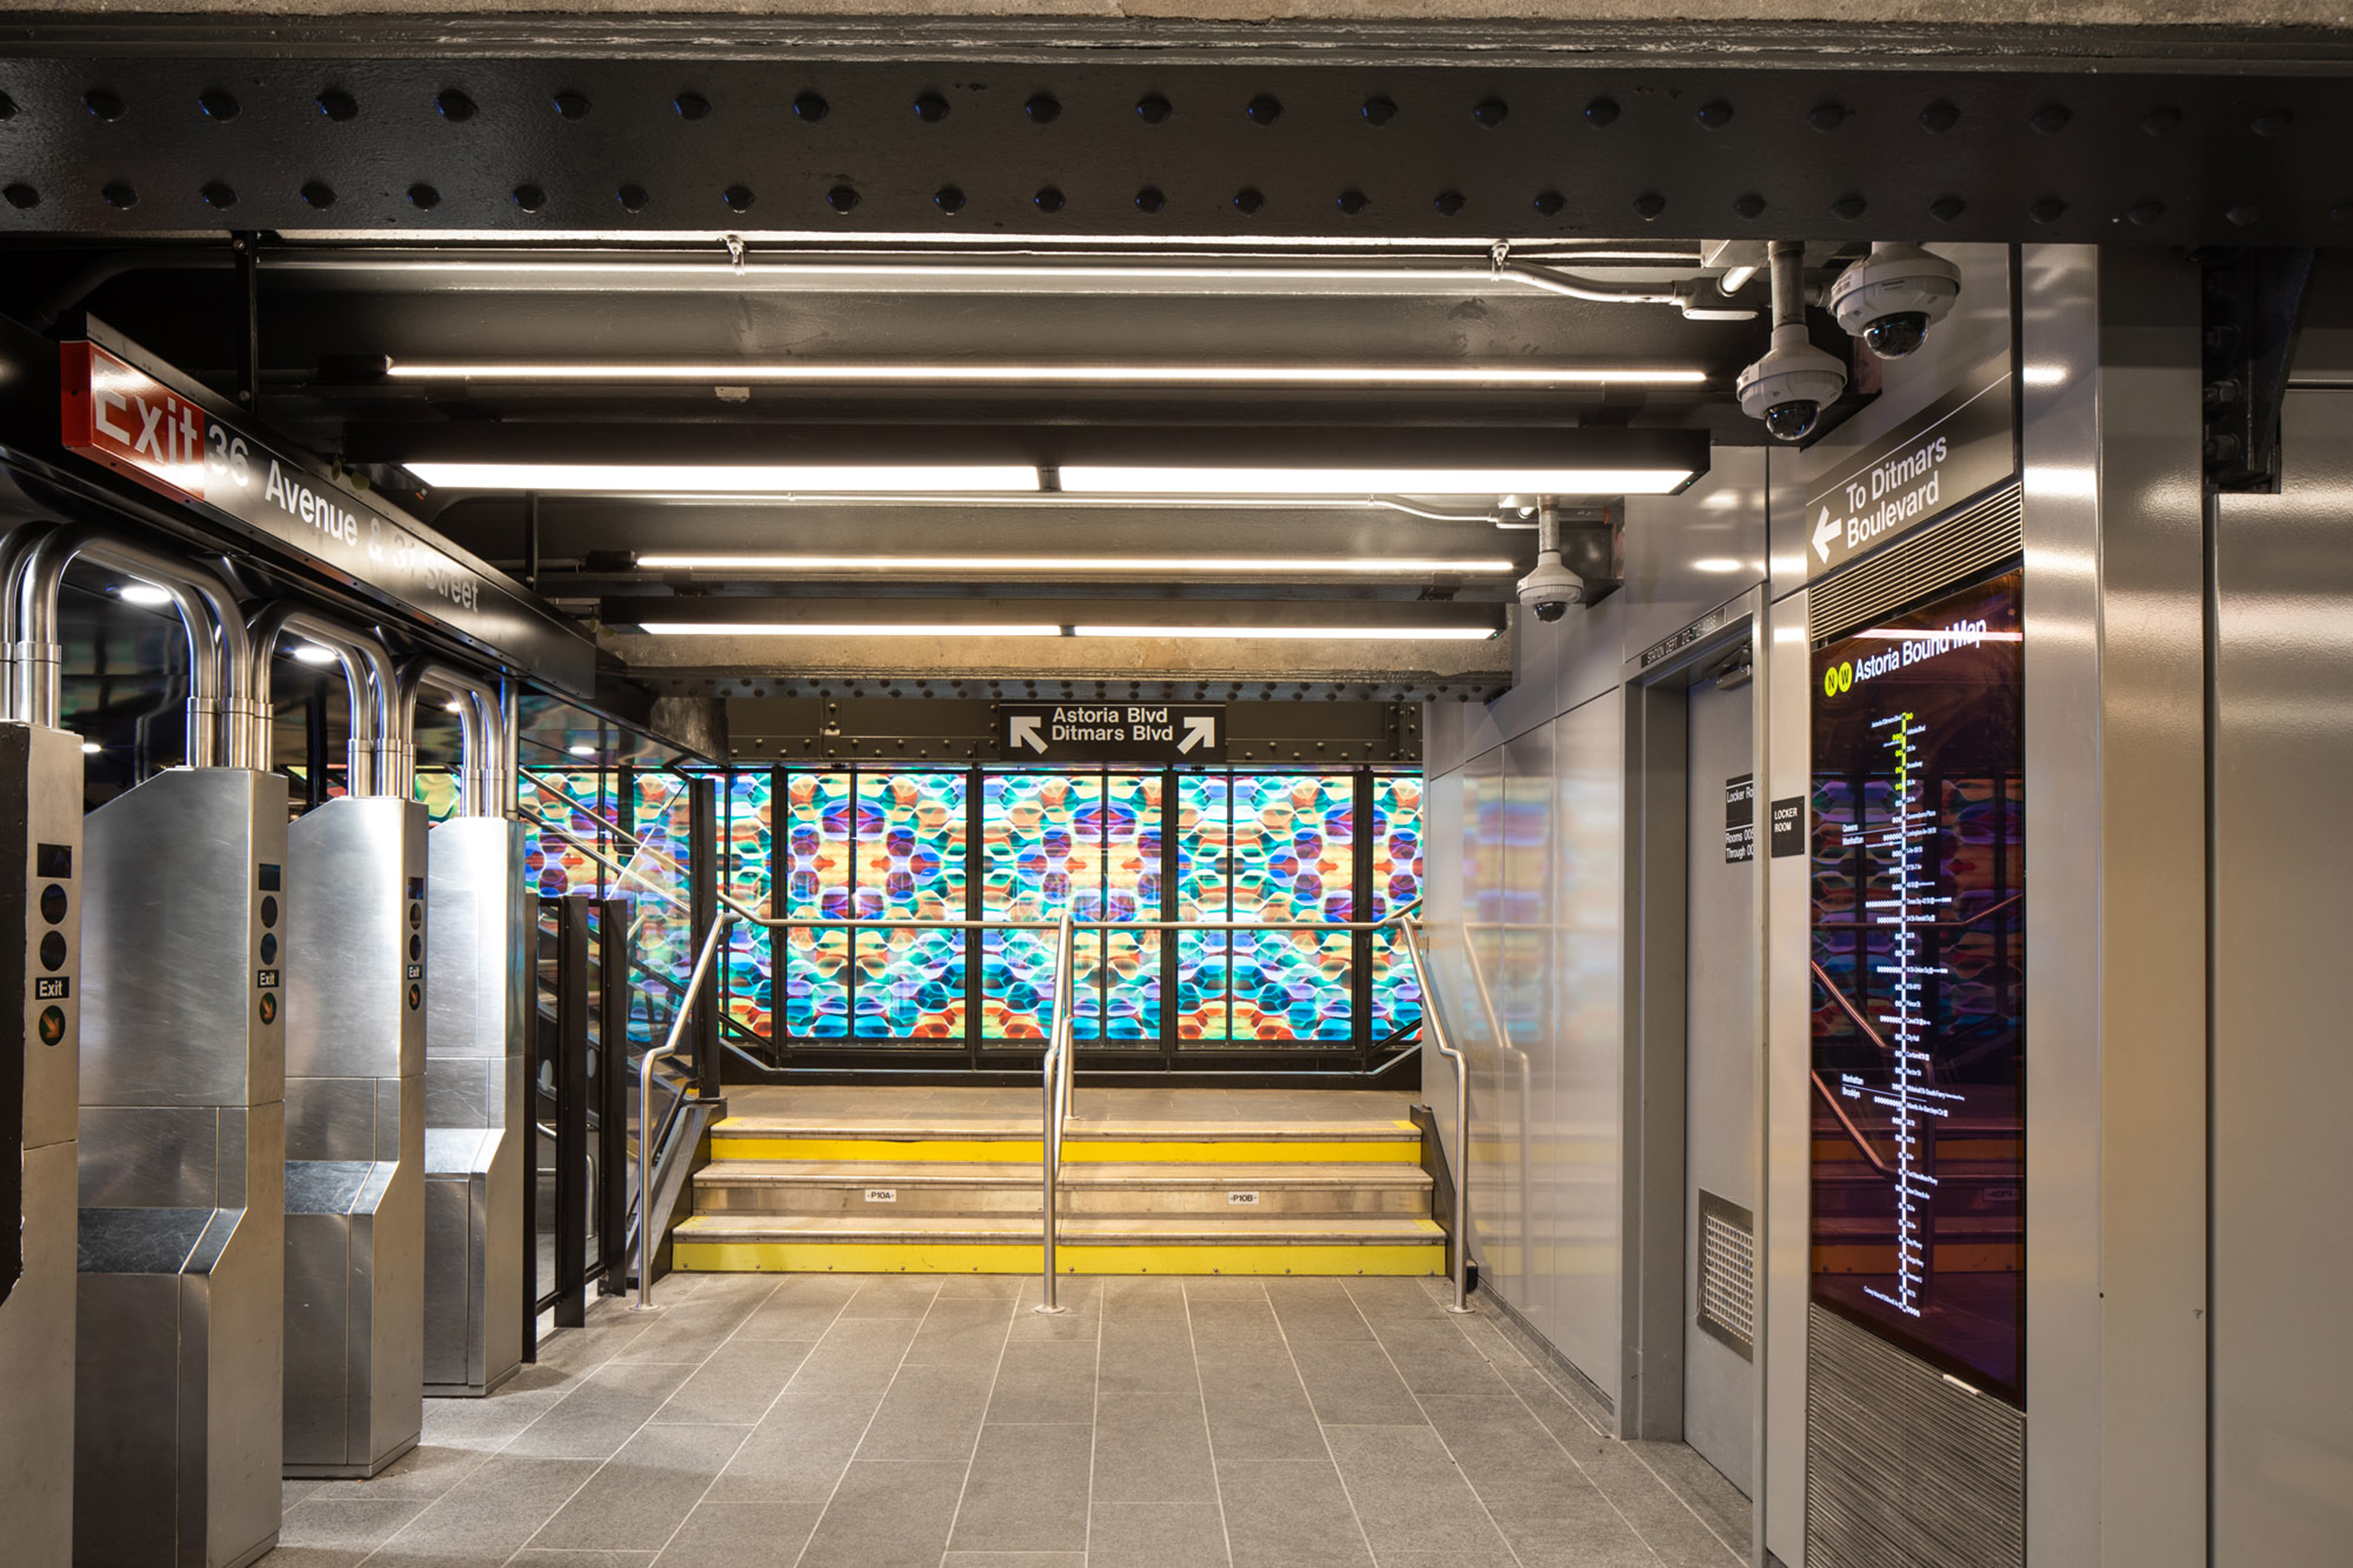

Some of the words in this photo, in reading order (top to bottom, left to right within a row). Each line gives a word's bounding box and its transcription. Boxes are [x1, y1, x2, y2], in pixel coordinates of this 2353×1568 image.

[1846, 482, 1866, 514] To
[1871, 436, 1947, 501] Ditmars
[94, 354, 197, 477] Exit
[209, 424, 250, 487] 36
[265, 459, 358, 546] Avenue
[424, 552, 478, 613] Street
[1847, 470, 1939, 549] Boulevard
[1855, 647, 1899, 683] Astoria
[1902, 626, 1949, 666] Bound
[1953, 619, 1986, 648] Map
[1053, 707, 1118, 723] Astoria
[1128, 707, 1167, 723] Blvd
[1052, 725, 1124, 741] Ditmars
[1133, 725, 1173, 741] Blvd
[1727, 789, 1745, 803] Locker
[1774, 807, 1798, 820] LOCKER
[1774, 821, 1792, 832] ROOM
[1726, 832, 1742, 843] Rooms
[1726, 846, 1746, 859] Through
[260, 973, 275, 986] Exit
[409, 967, 420, 979] Exit
[39, 980, 63, 996] Exit
